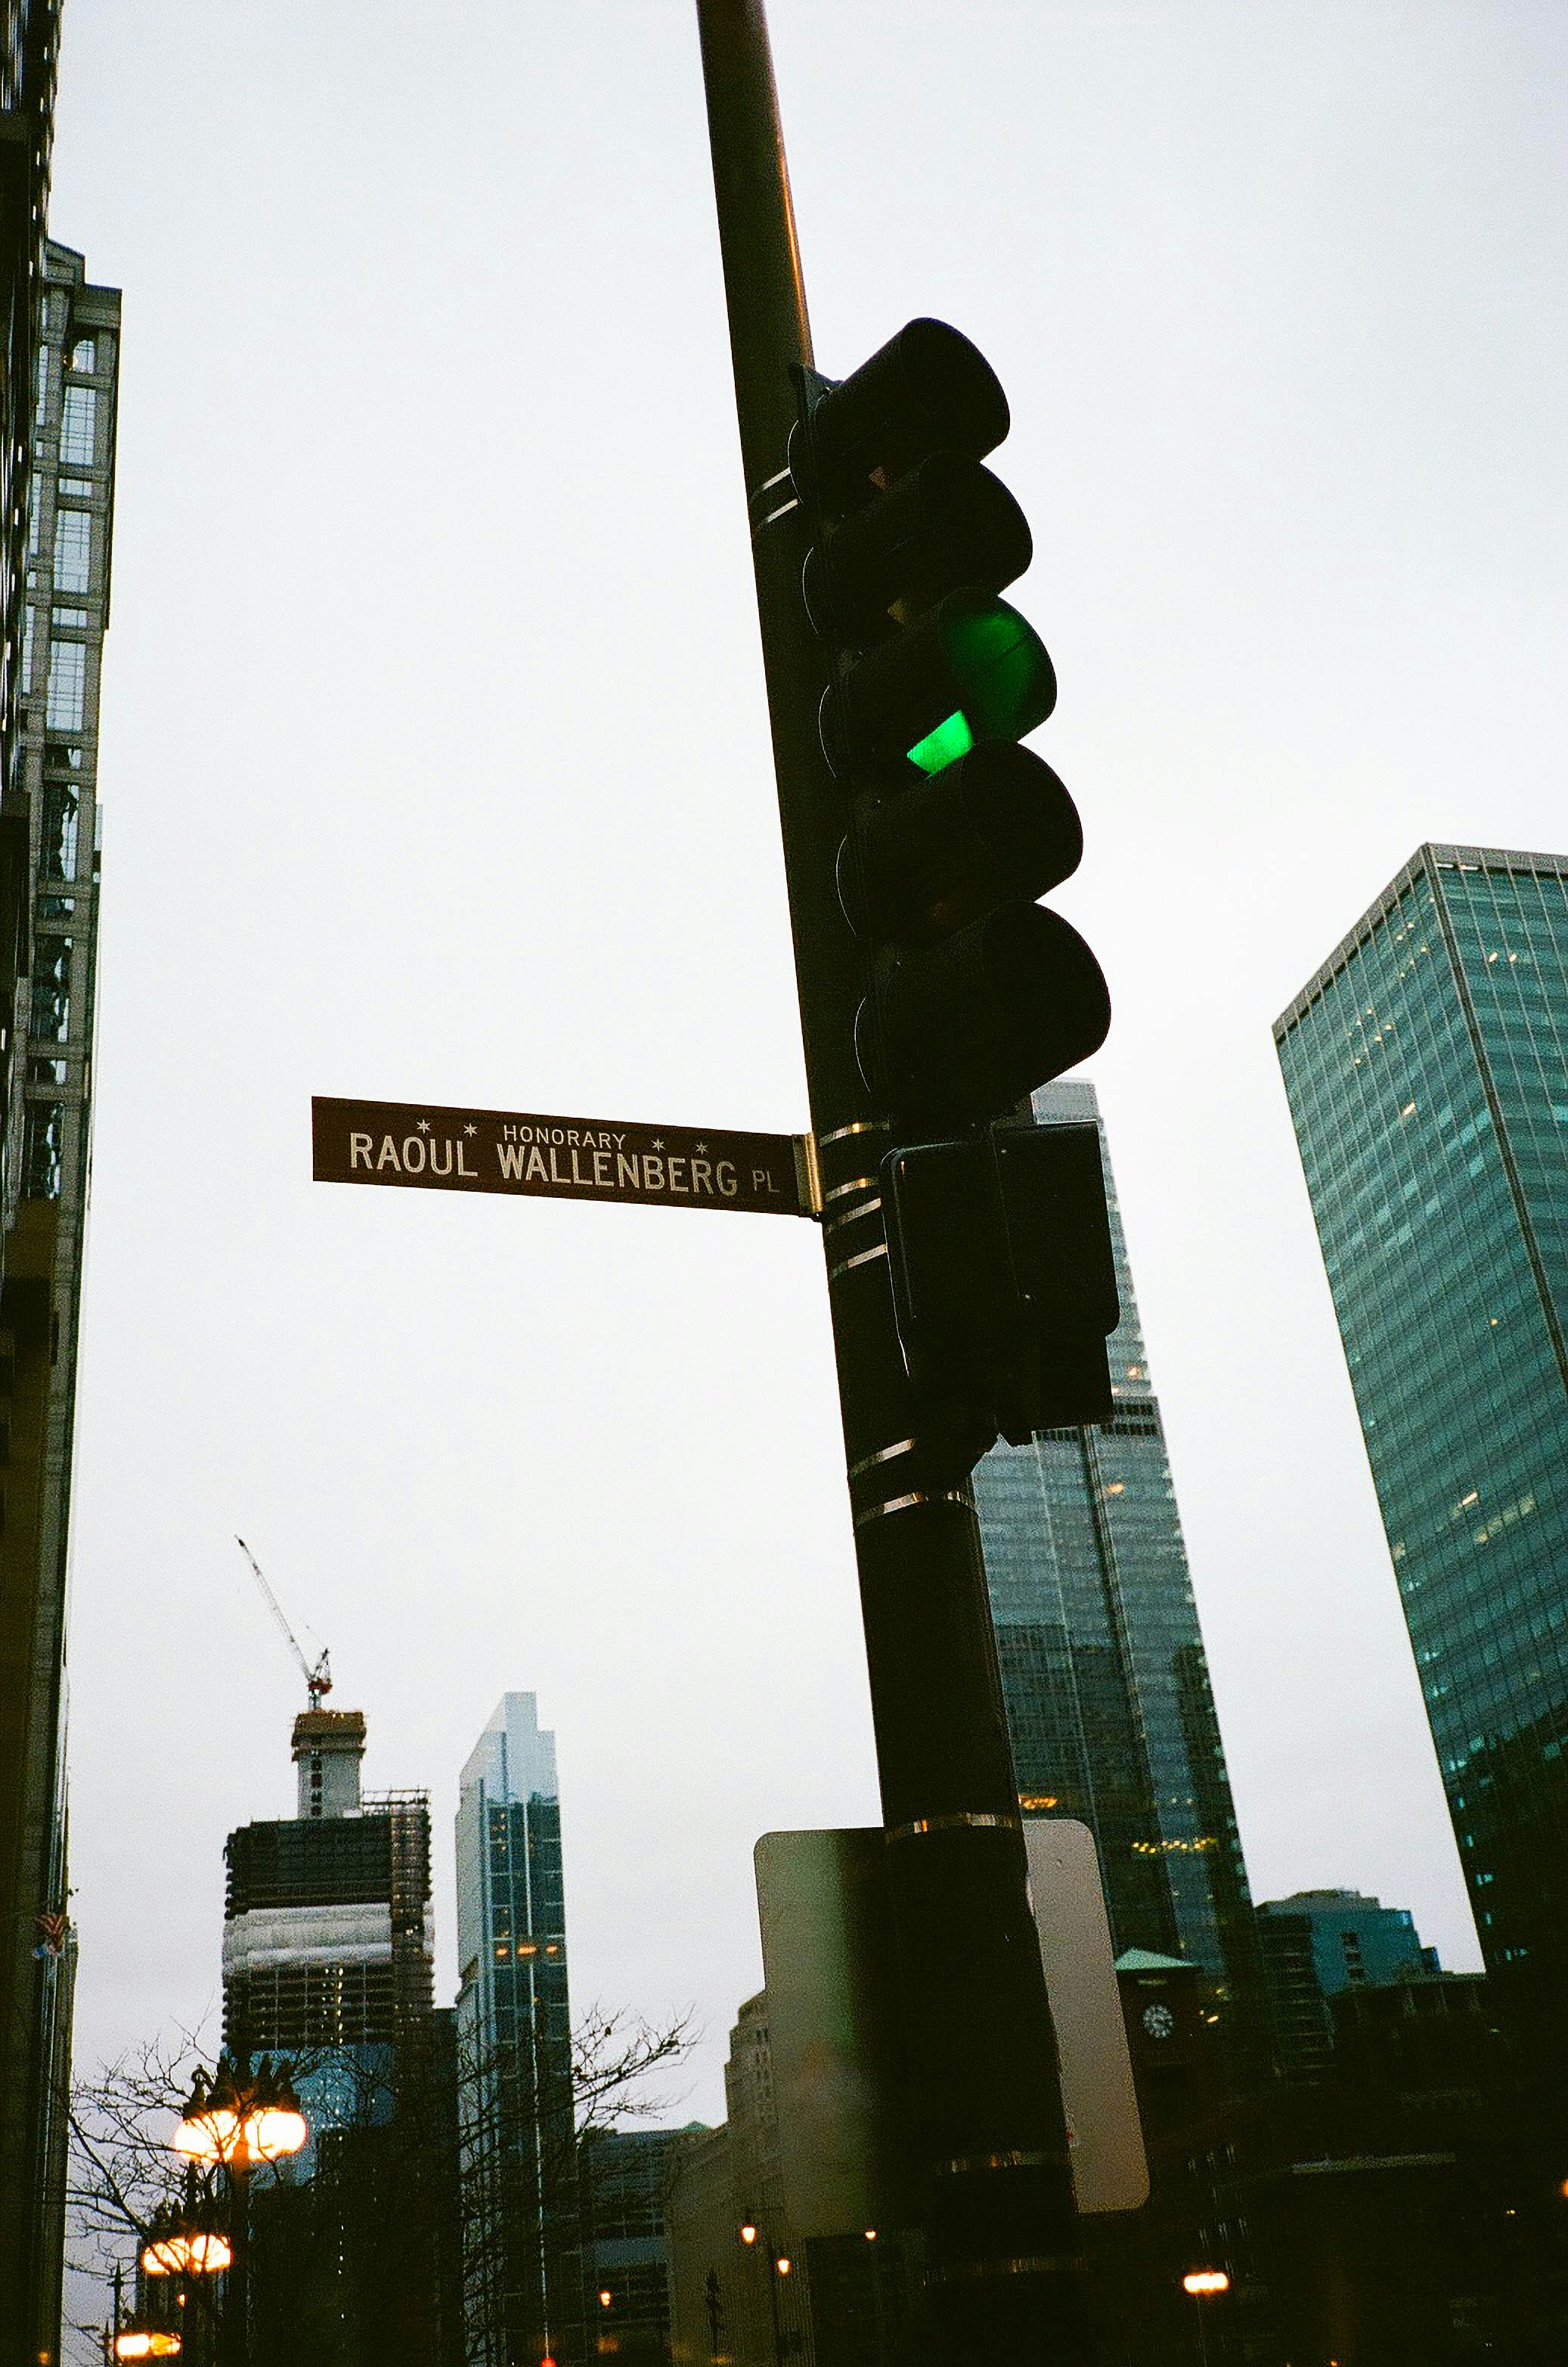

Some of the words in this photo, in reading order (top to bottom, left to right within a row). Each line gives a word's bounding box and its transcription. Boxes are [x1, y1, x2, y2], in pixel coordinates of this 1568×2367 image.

[504, 1125, 627, 1150] HONORARY
[349, 1132, 478, 1177] RAOUL
[497, 1143, 737, 1196] WALLENBERG
[752, 1169, 780, 1193] PL
